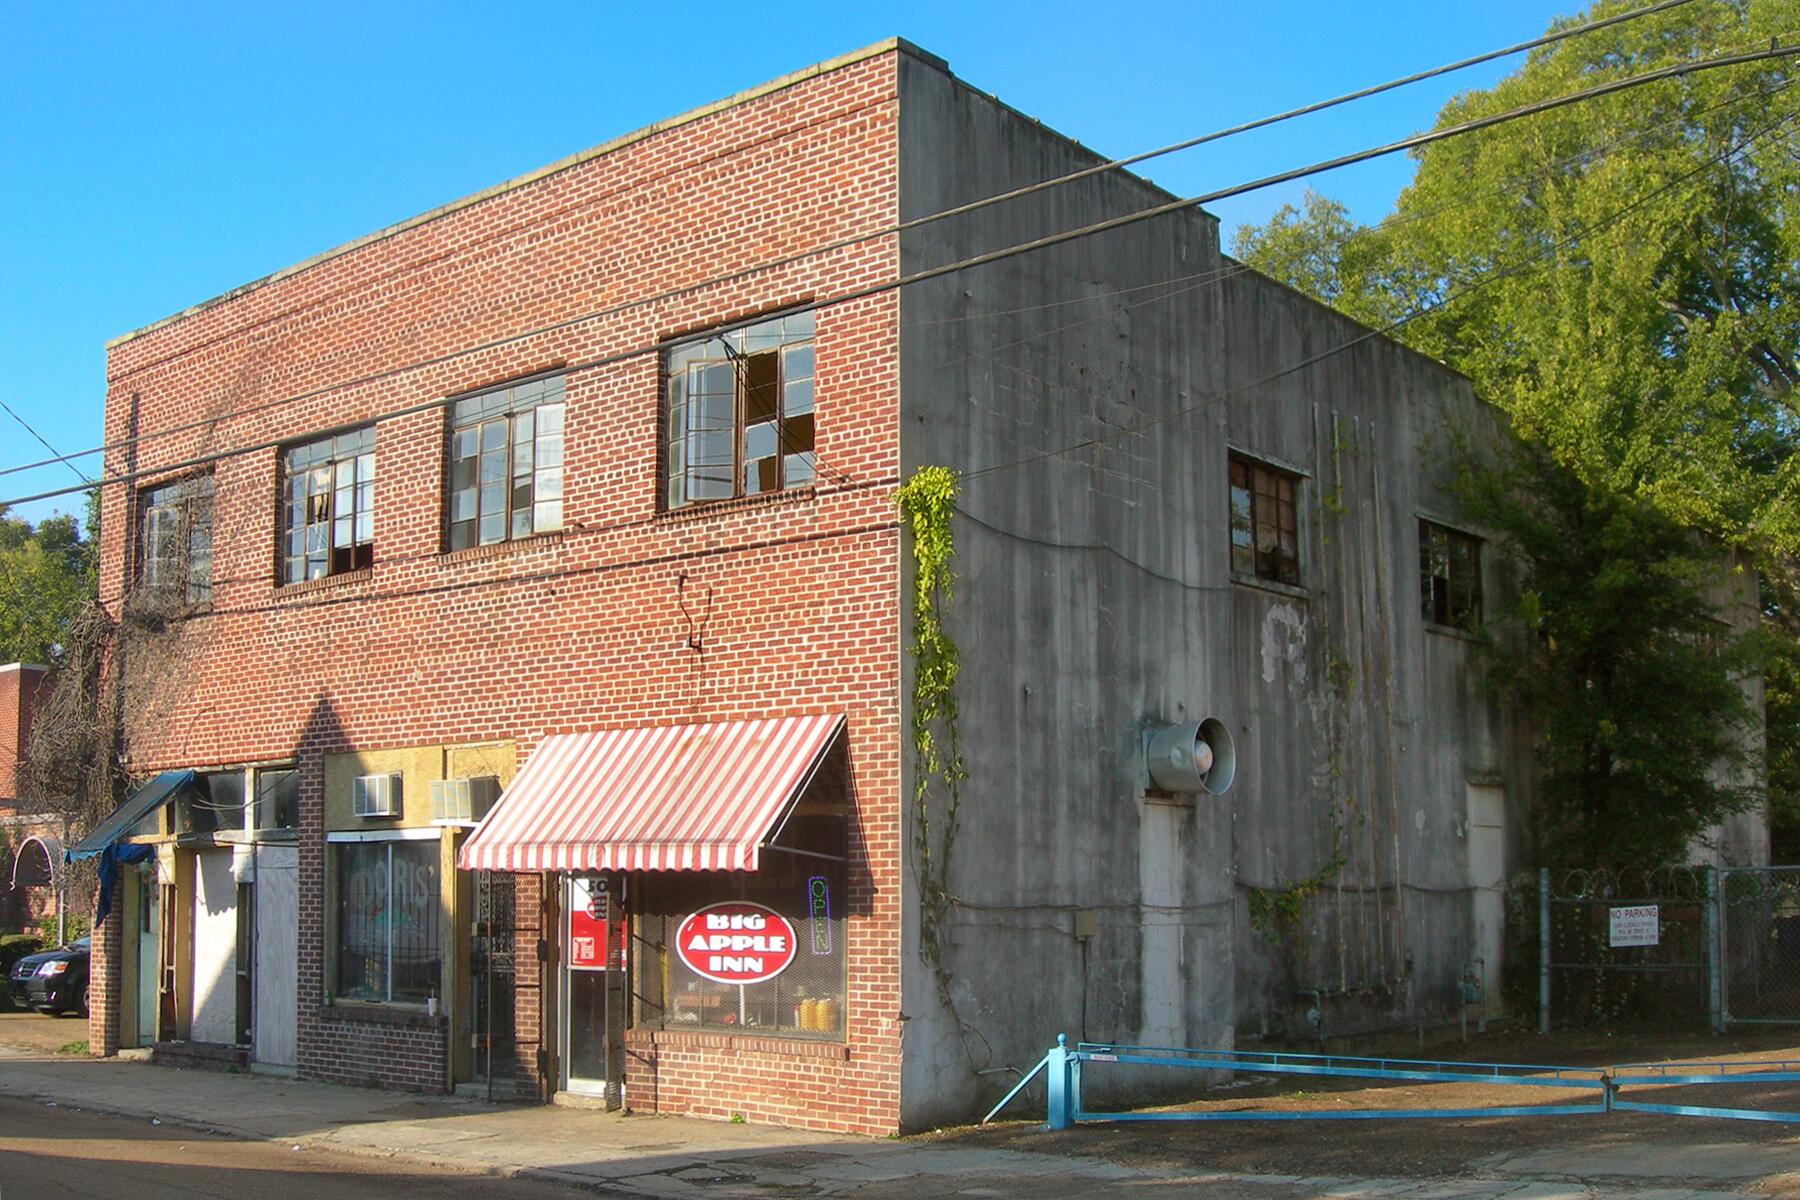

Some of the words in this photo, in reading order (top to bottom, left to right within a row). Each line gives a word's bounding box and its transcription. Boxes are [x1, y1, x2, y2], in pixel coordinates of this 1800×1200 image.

[812, 880, 828, 950] OPEN
[1610, 909, 1621, 919] NO
[1625, 907, 1657, 918] PARKING
[706, 914, 766, 930] BIG
[687, 934, 786, 952] APPLE
[708, 956, 763, 973] INN
